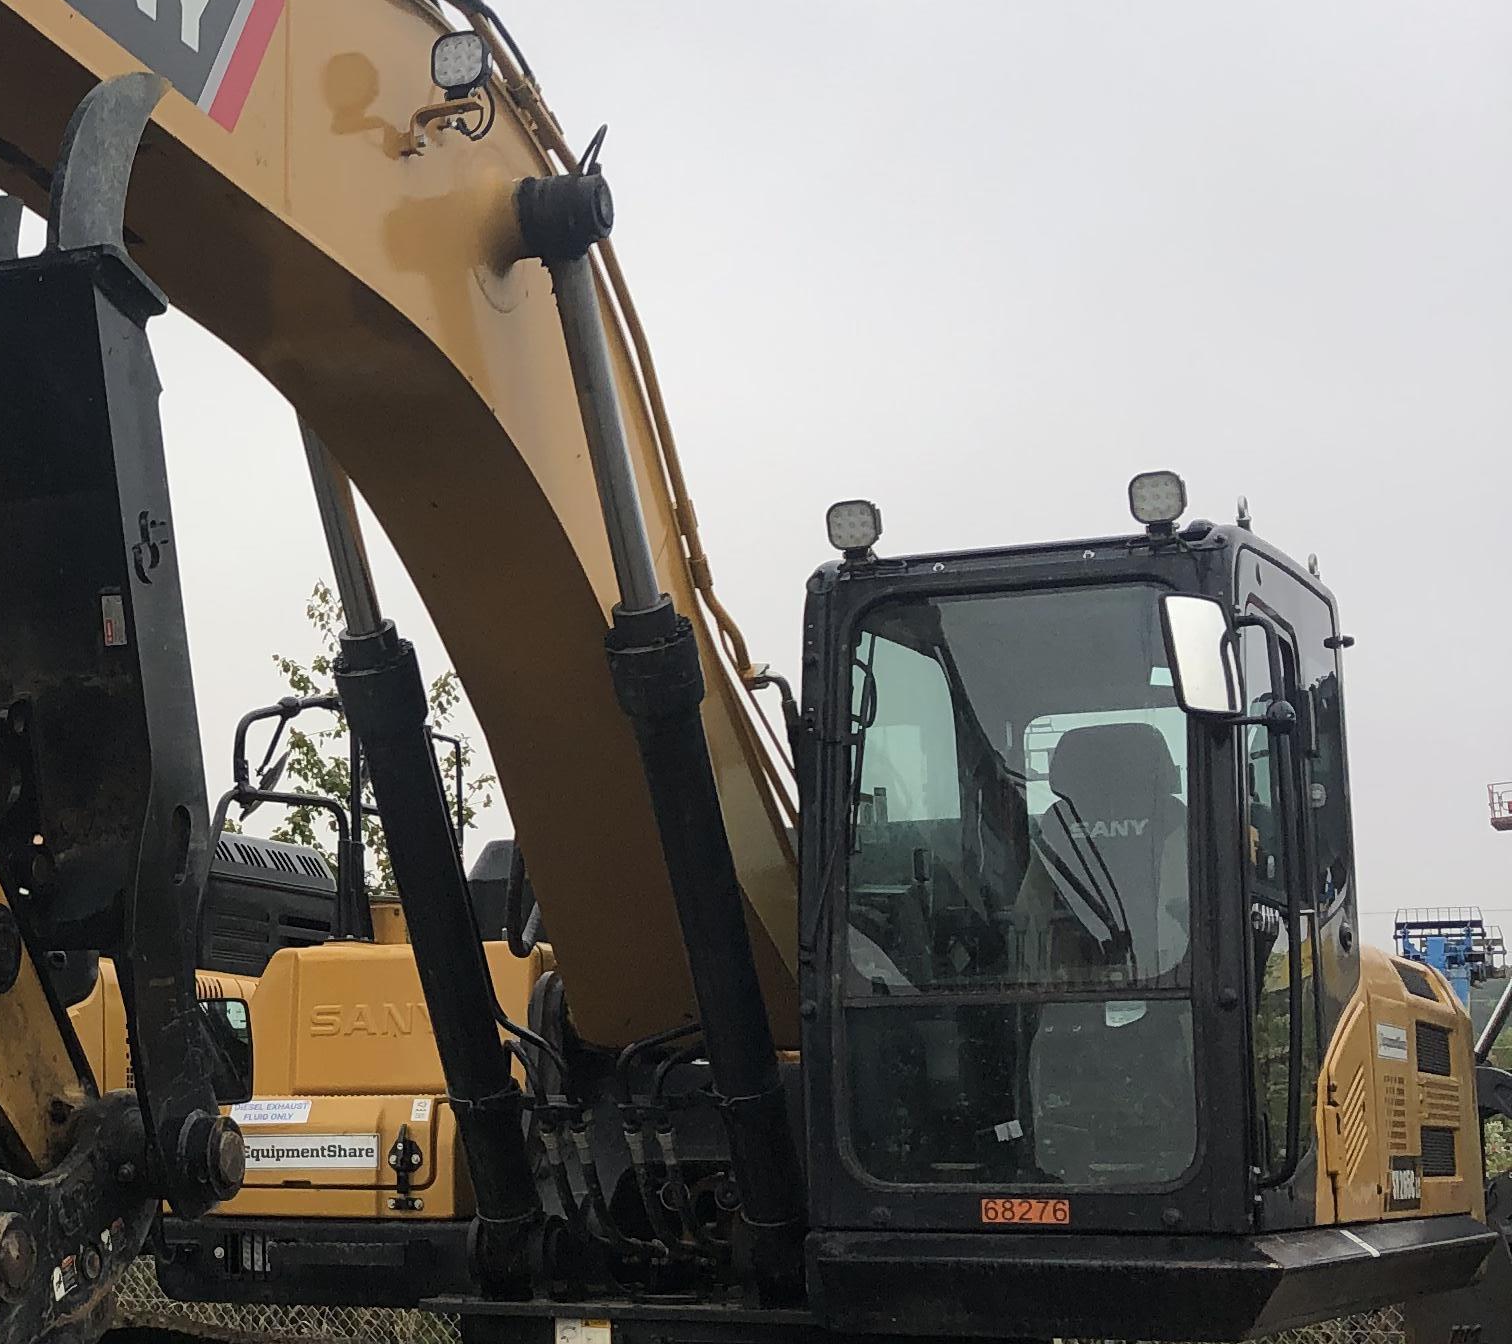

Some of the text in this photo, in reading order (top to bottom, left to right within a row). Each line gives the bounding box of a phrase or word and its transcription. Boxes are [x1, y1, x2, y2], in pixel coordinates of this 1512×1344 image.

[266, 1102, 308, 1111] EXHAUST
[243, 1112, 294, 1121] FLUID ONLY
[245, 1144, 375, 1162] EquipmentShare
[984, 1199, 1068, 1222] 68276
